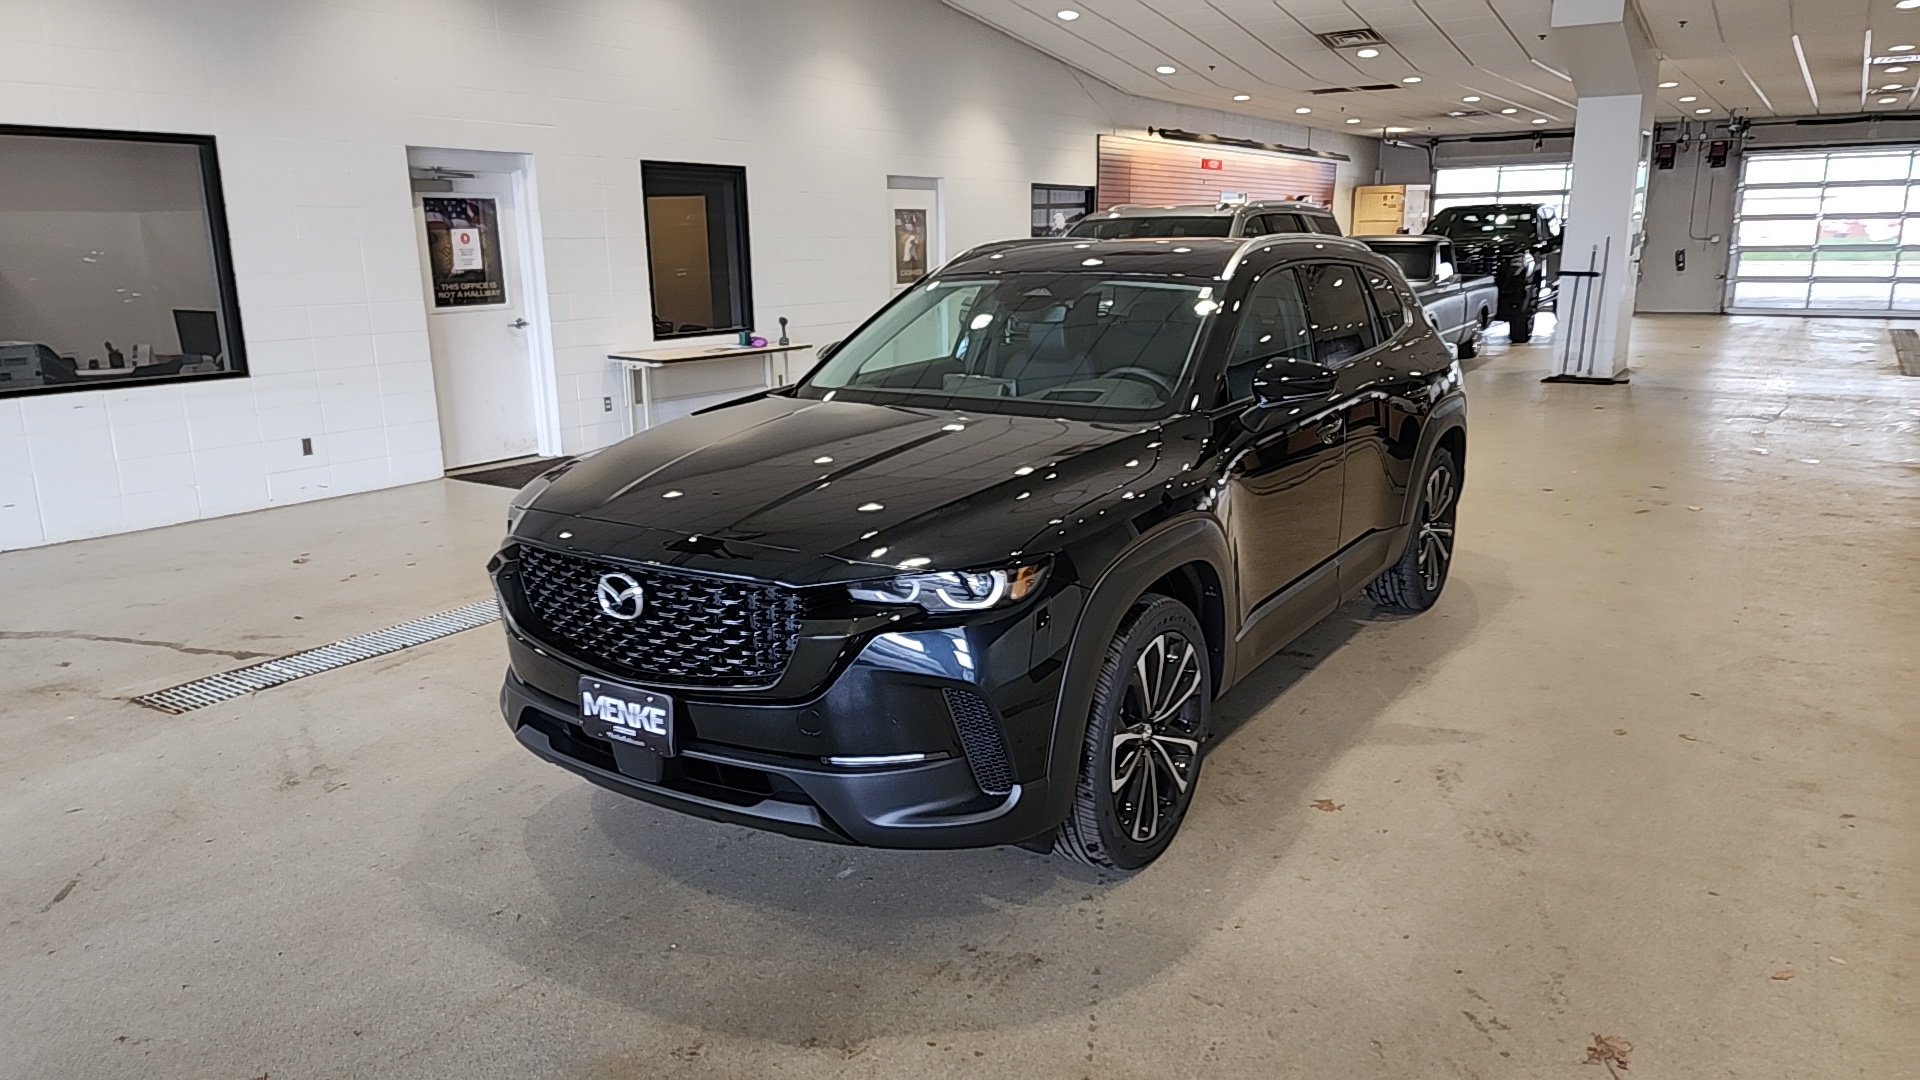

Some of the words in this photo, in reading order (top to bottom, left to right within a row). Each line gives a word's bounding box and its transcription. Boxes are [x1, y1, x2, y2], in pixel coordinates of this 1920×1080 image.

[440, 283, 459, 291] THIS
[460, 281, 488, 290] OFFICE
[488, 281, 498, 289] IS
[437, 291, 456, 299] NOT
[456, 290, 464, 298] A
[463, 289, 501, 298] HALLWAY
[582, 691, 667, 736] MENKE
